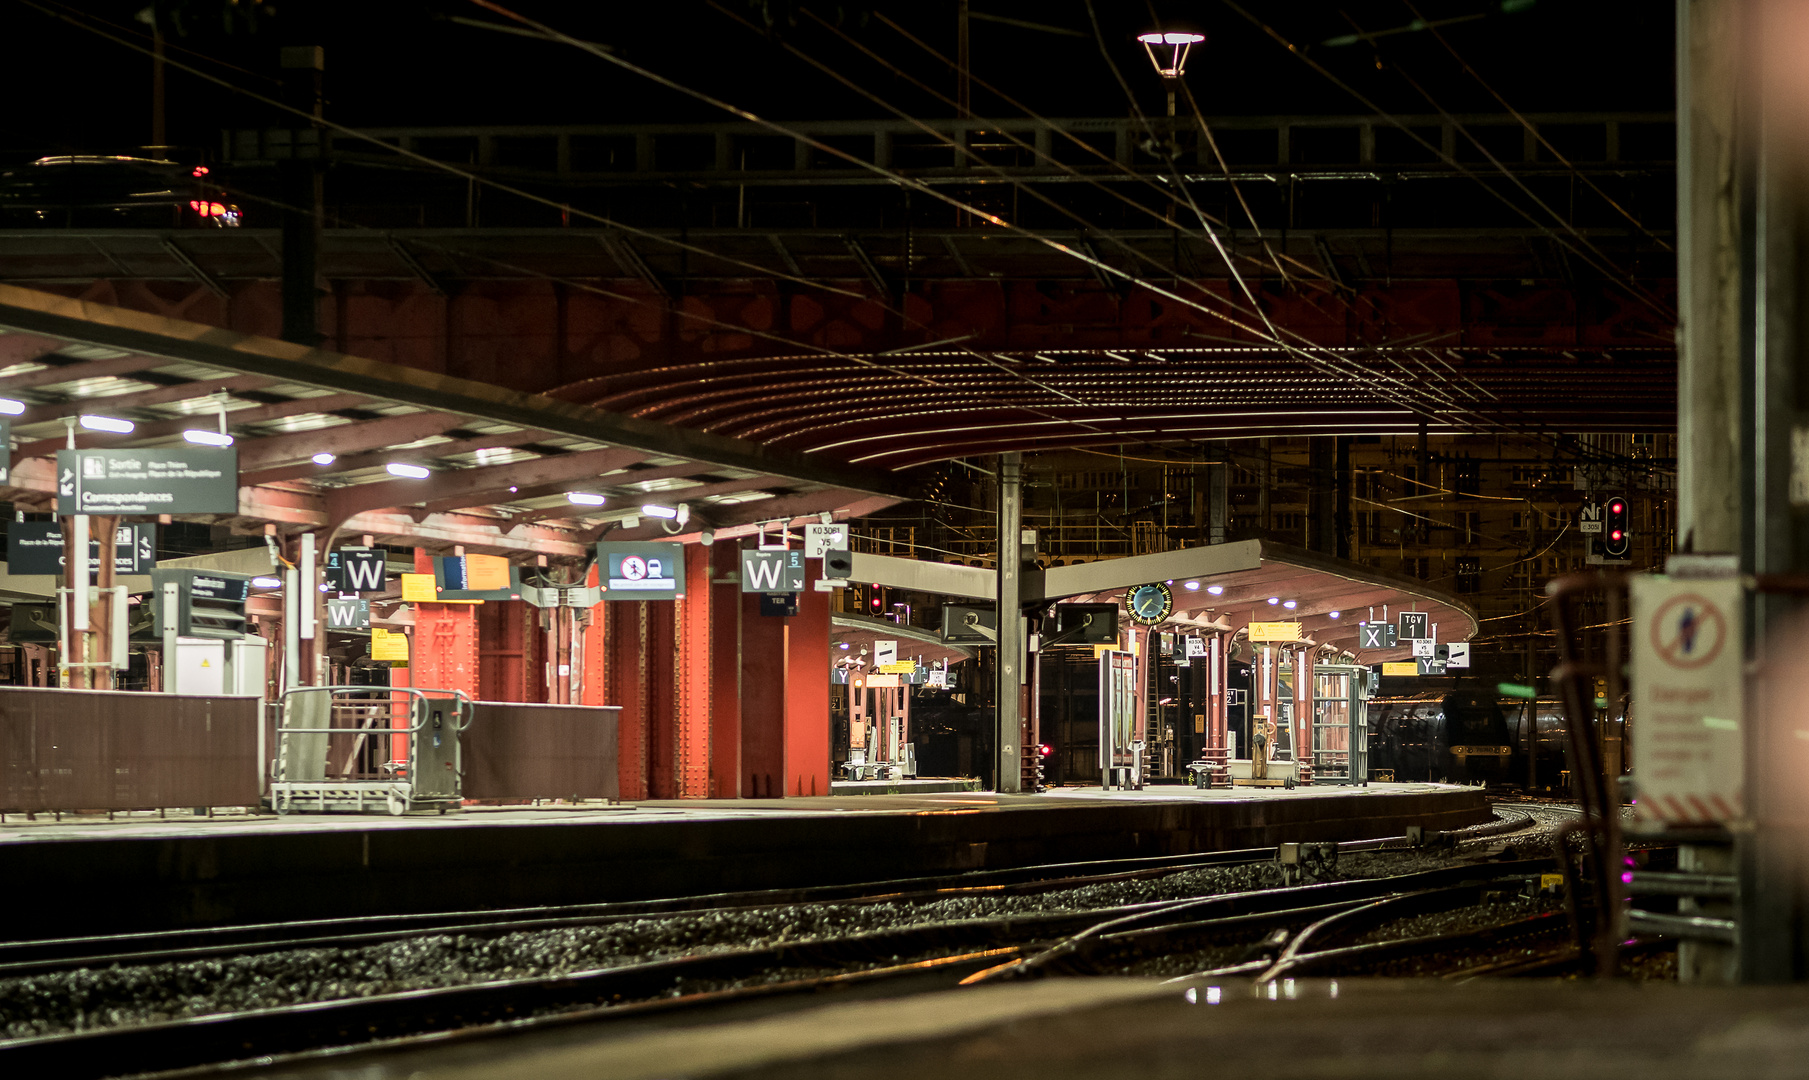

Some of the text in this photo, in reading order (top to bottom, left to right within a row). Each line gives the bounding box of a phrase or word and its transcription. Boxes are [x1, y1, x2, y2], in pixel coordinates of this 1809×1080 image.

[108, 458, 142, 470] Sortie
[82, 491, 174, 505] Correspondances
[330, 557, 339, 567] 4
[791, 556, 799, 567] 5
[346, 560, 384, 590] W
[746, 559, 783, 590] W
[330, 605, 356, 626] W
[1405, 615, 1422, 624] TGV
[1365, 629, 1380, 647] X
[1409, 624, 1415, 638] 1
[1422, 659, 1433, 674] Y
[839, 670, 848, 684] Y
